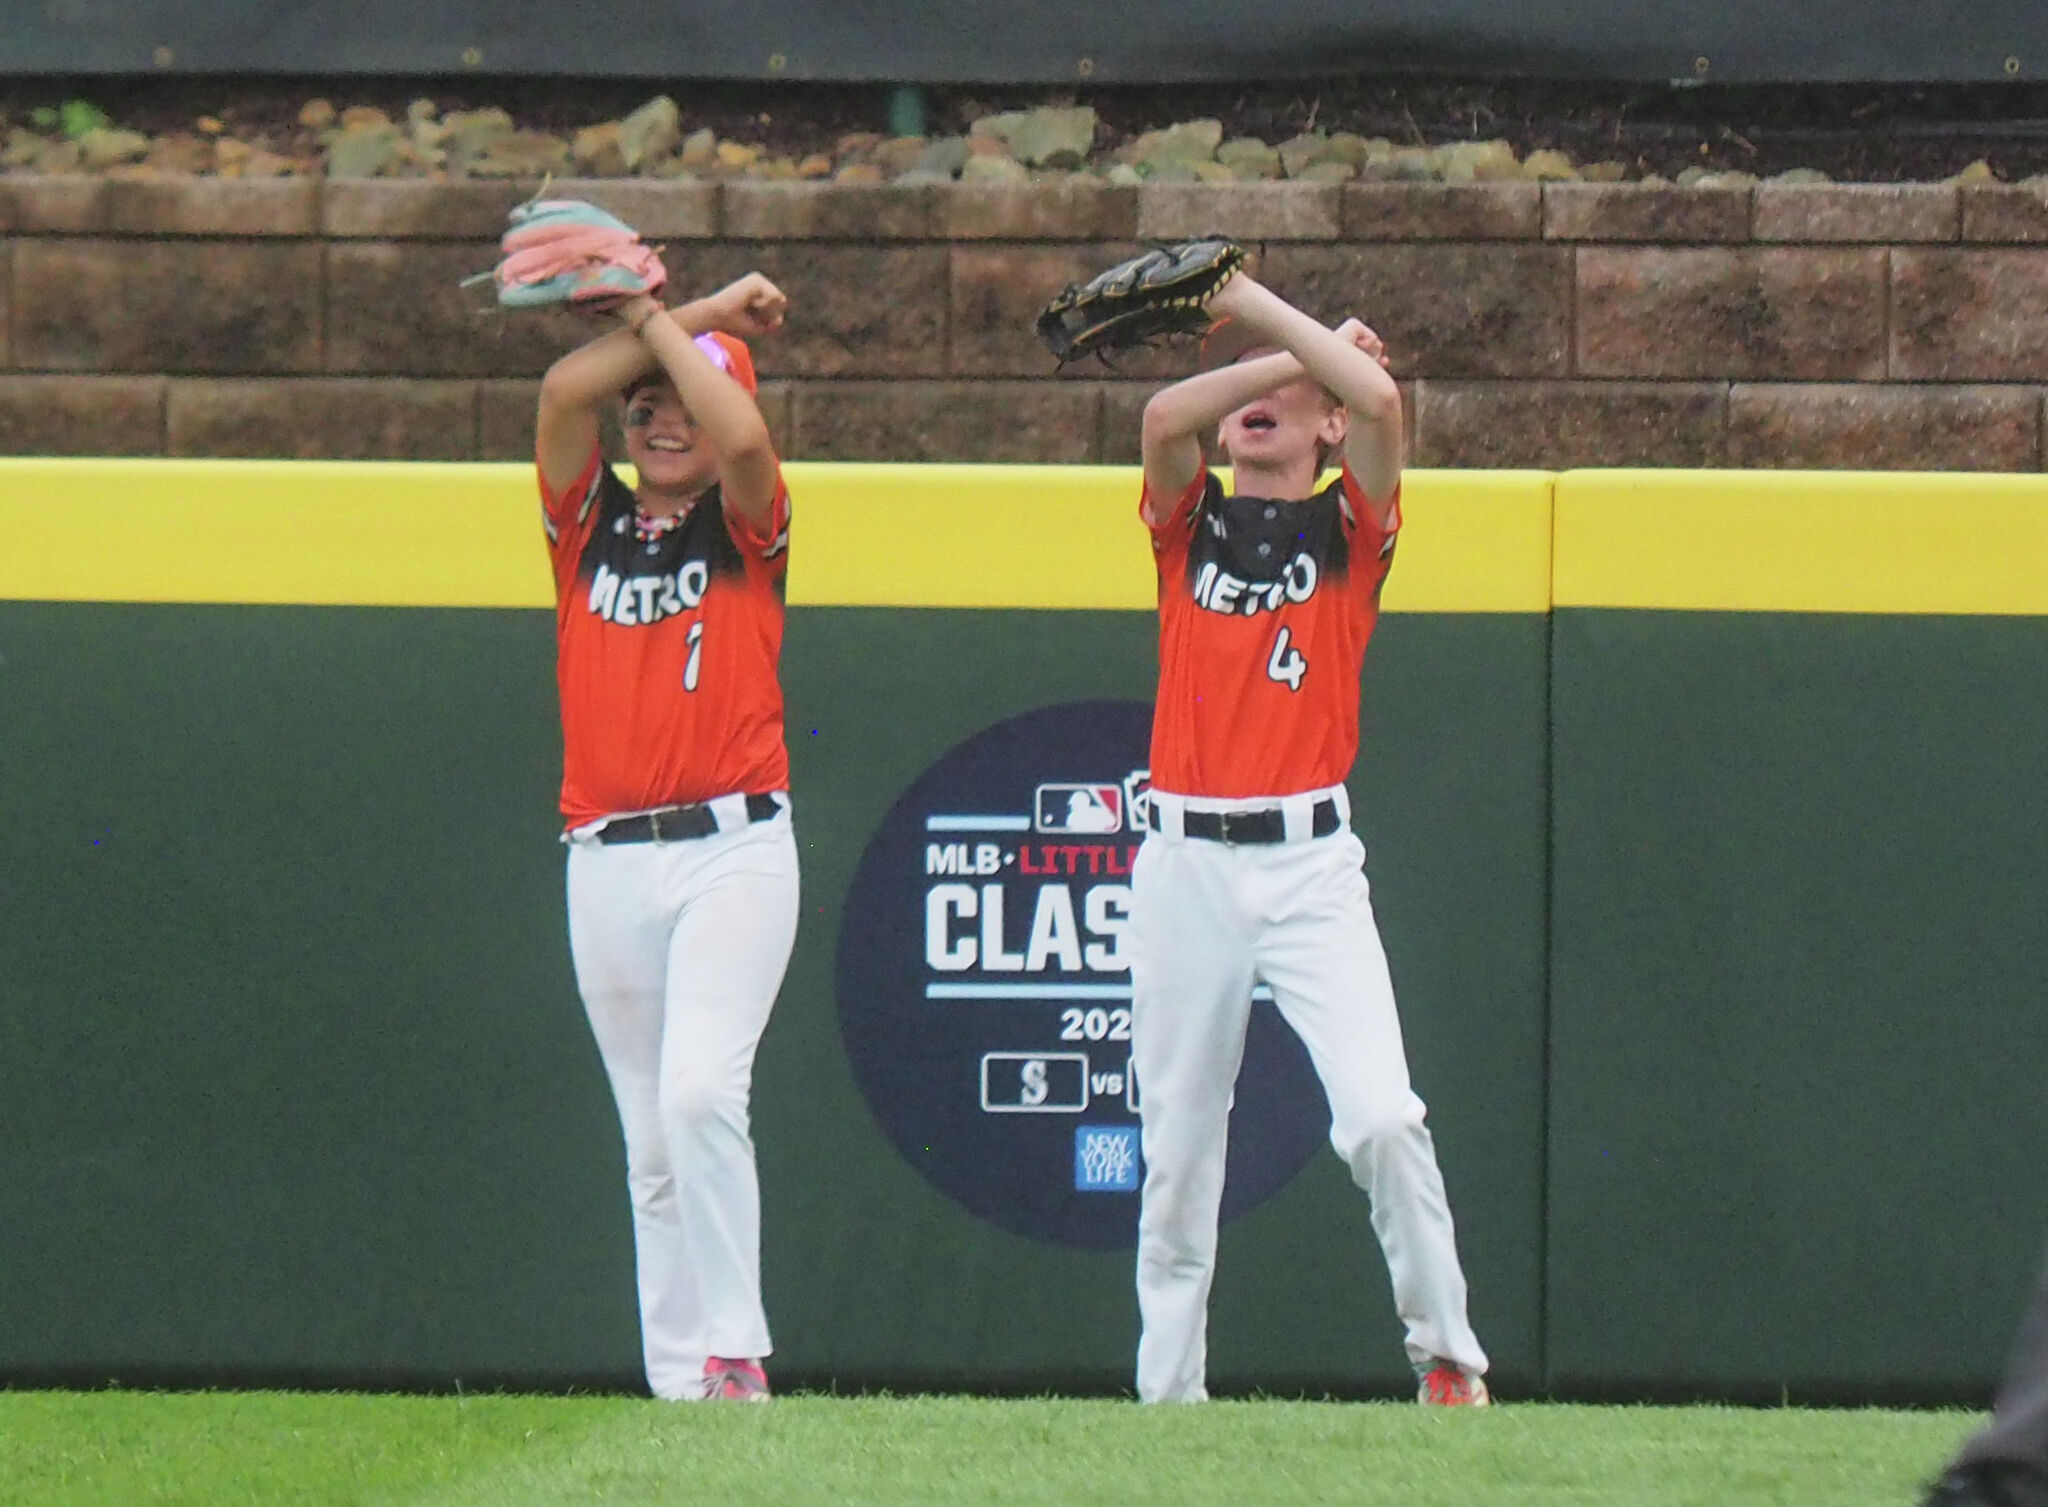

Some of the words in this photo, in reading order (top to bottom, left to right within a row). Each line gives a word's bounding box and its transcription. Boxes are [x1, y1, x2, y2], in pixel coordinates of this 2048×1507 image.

[588, 560, 708, 625] METRO
[682, 620, 704, 692] 1
[1267, 625, 1308, 692] 4
[926, 883, 1131, 971] CLAS
[1060, 1007, 1132, 1041] 202
[1080, 1150, 1133, 1168] YORK
[1086, 1133, 1129, 1152] NEW
[1086, 1165, 1127, 1184] LIFE
